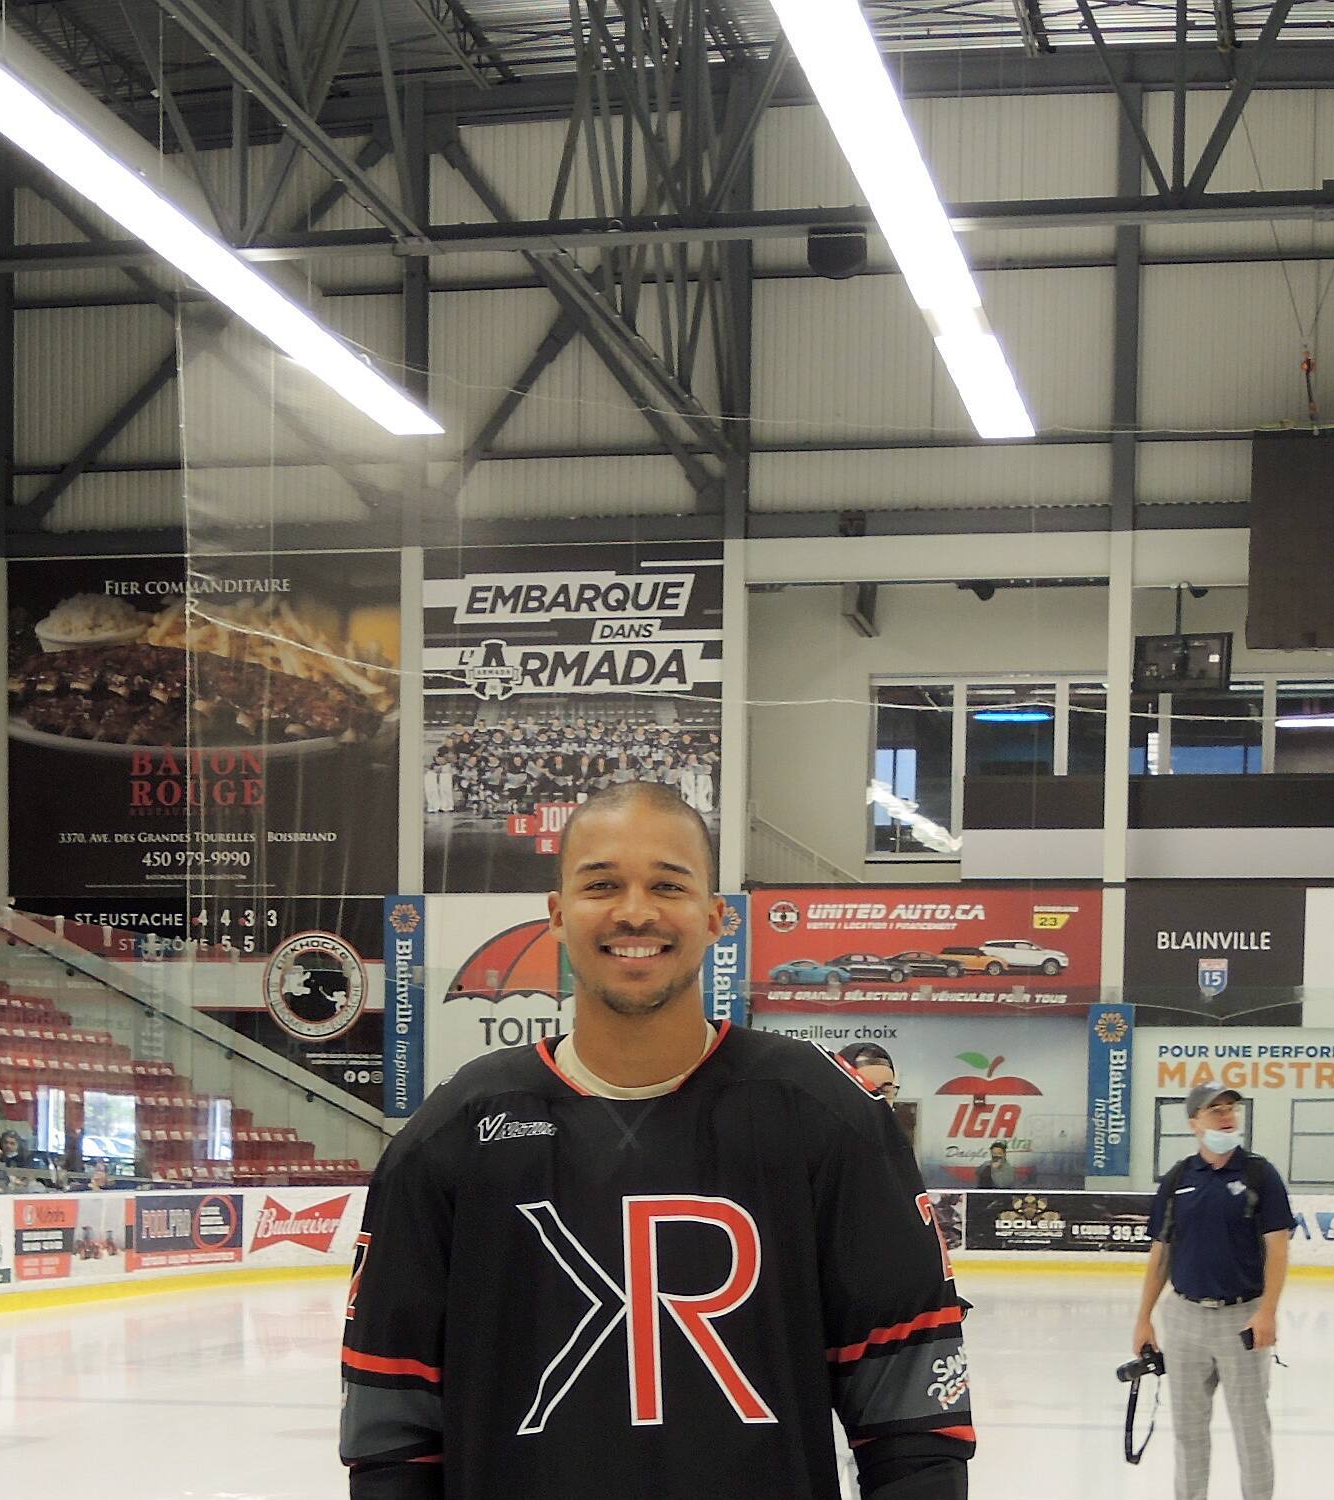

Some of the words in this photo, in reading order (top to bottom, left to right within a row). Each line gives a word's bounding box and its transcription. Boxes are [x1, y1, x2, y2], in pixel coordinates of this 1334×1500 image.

[105, 579, 142, 595] FIER
[145, 578, 291, 596] COMMANDITAIRE
[465, 581, 685, 615] EMBARQUE
[600, 623, 654, 639] DANS
[130, 779, 265, 807] ROUGE
[514, 817, 527, 834] LE
[115, 833, 135, 844] DES
[137, 832, 191, 844] GRANDES
[267, 831, 338, 843] BOISBRIAND
[542, 840, 553, 852] DE
[142, 851, 172, 868] 450
[175, 850, 250, 868] 979-9990
[74, 912, 183, 928] ST-EUSTACHE
[807, 904, 888, 920] UNITED
[889, 903, 985, 920] AUTO.CA
[1039, 917, 1057, 927] 23
[1157, 931, 1271, 950] BLAINVILLE
[395, 938, 413, 1035] Blainville
[713, 943, 738, 1021] Blain
[1203, 971, 1222, 985] 15
[768, 991, 792, 1000] UNE
[845, 989, 909, 1001] SÉLECTION
[932, 990, 995, 1002] VÉHICULES
[1033, 994, 1068, 1003] TOUS
[784, 1026, 850, 1039] meilleur
[854, 1026, 898, 1038] choix
[1158, 1045, 1213, 1058] POUR
[1216, 1045, 1253, 1058] UNE
[394, 1040, 412, 1111] inspirante
[1109, 1048, 1129, 1146] Blainville
[947, 1104, 1023, 1138] IGA
[1092, 1097, 1110, 1169] inspirante
[256, 1206, 340, 1241] Budweiser
